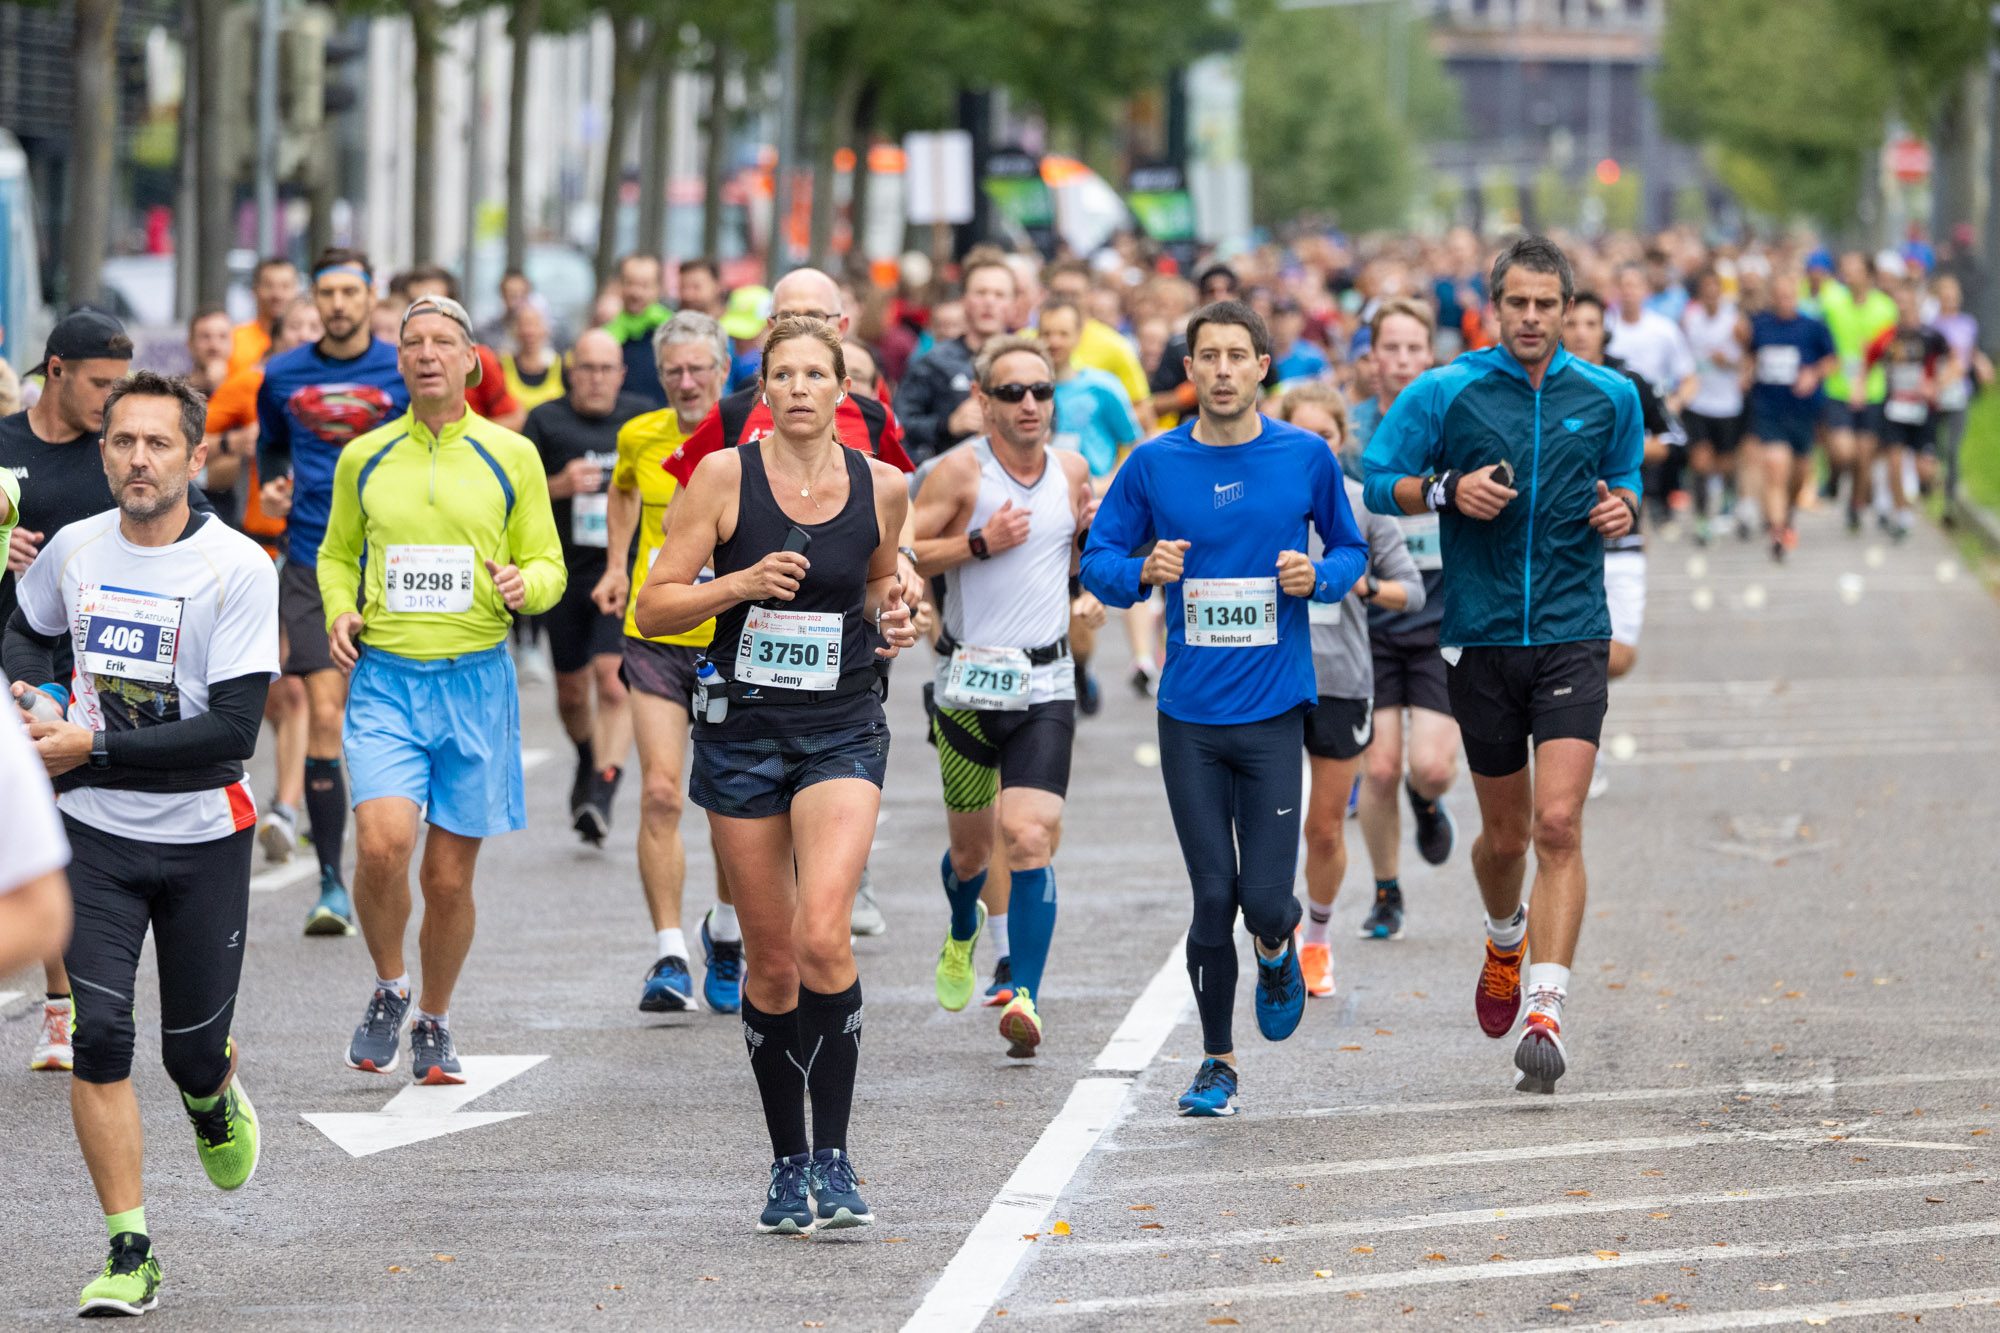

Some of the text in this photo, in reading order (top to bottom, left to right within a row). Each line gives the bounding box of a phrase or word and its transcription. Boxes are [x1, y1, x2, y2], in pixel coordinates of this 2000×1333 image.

[1214, 481, 1244, 509] RUN
[403, 572, 453, 590] 9298
[111, 594, 142, 605] September
[404, 595, 447, 608] DIRK
[773, 613, 807, 621] September
[1204, 606, 1257, 626] 1340
[808, 625, 841, 633] RUTRONIK
[97, 625, 145, 654] 406
[1210, 634, 1252, 643] Reinhard
[758, 640, 819, 666] 3750
[105, 659, 126, 673] Erik
[746, 670, 752, 678] C
[770, 673, 803, 687] Jenny
[966, 670, 1013, 691] 2719
